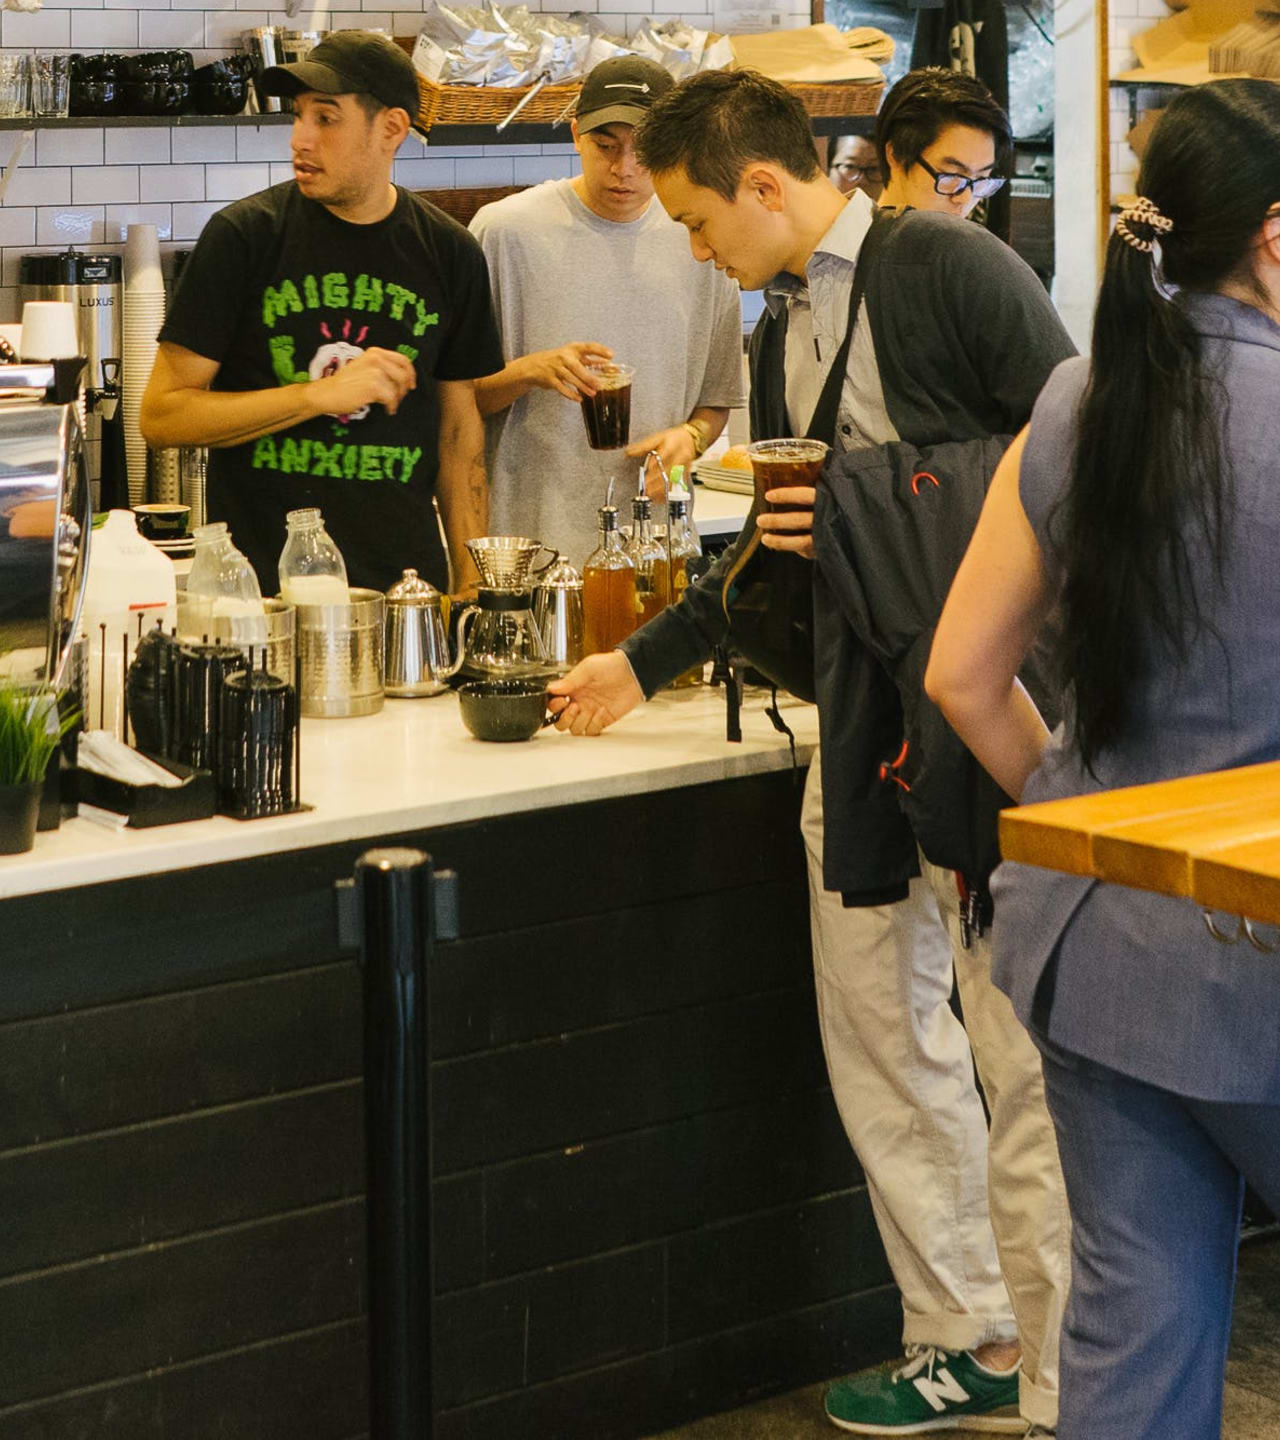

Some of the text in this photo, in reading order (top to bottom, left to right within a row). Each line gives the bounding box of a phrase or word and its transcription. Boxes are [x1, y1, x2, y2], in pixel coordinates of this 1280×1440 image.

[80, 297, 115, 308] LUXUS
[263, 272, 439, 336] MIGHTY
[252, 435, 422, 483] ANXIETY
